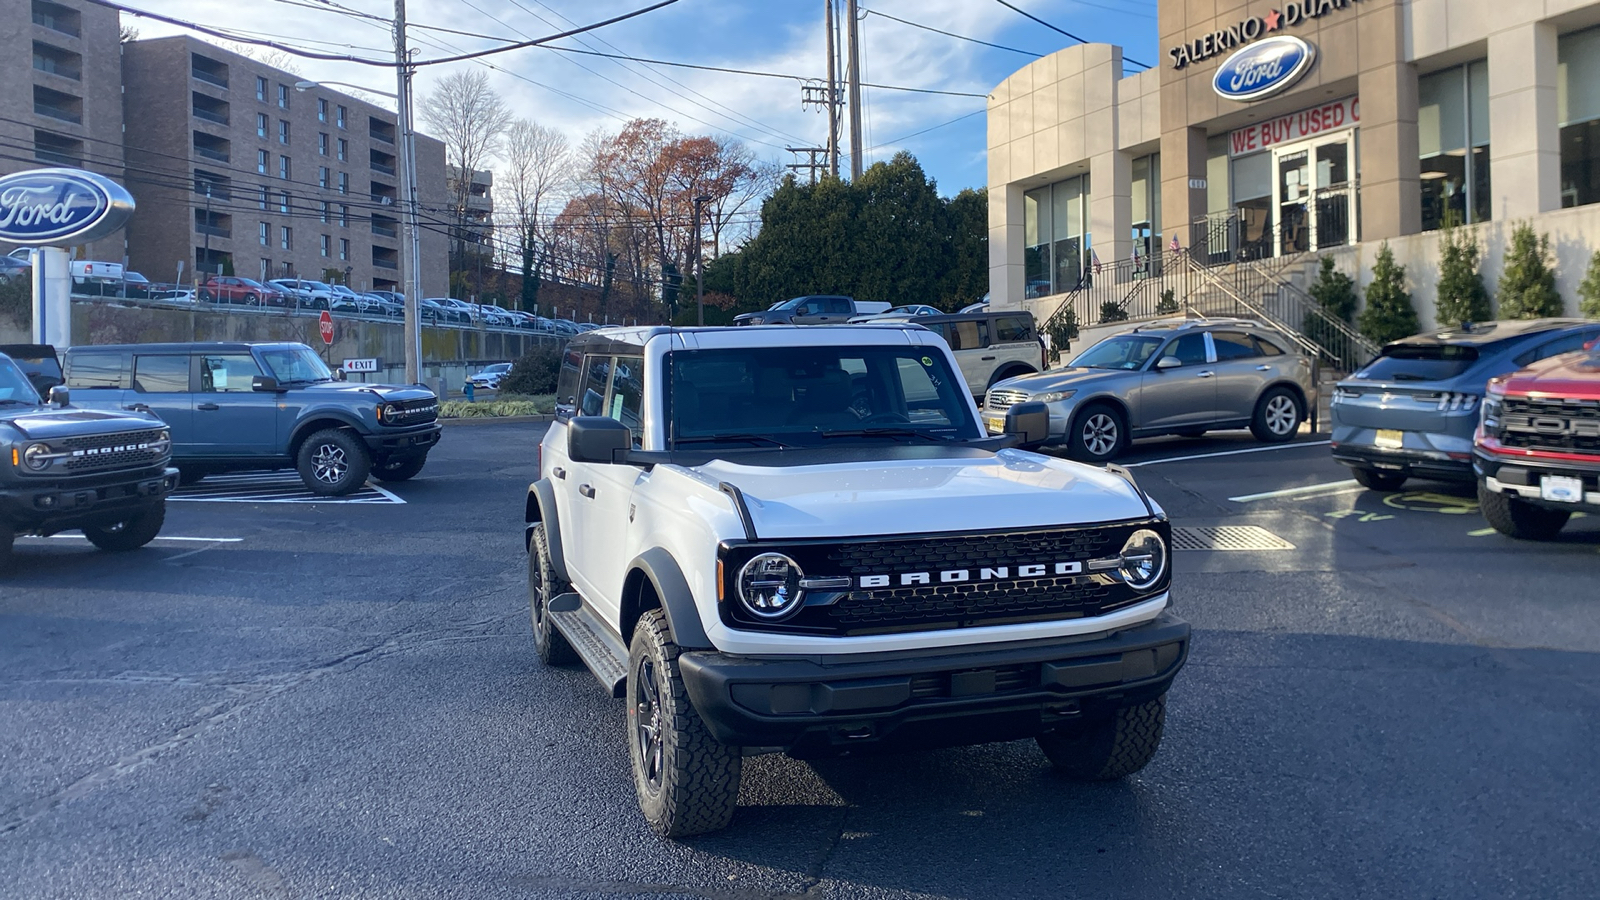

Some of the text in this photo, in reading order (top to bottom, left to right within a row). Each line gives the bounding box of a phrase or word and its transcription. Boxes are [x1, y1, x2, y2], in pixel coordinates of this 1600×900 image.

[1168, 16, 1261, 68] SALERNO
[1230, 56, 1283, 91] Ford
[1232, 127, 1256, 154] WE
[1261, 116, 1294, 146] BUY
[1299, 102, 1345, 136] USED
[0, 185, 76, 229] Ford
[321, 321, 333, 334] STOP
[355, 361, 373, 370] EXIT
[72, 443, 148, 457] BRONCO
[859, 561, 1082, 588] BRONCO
